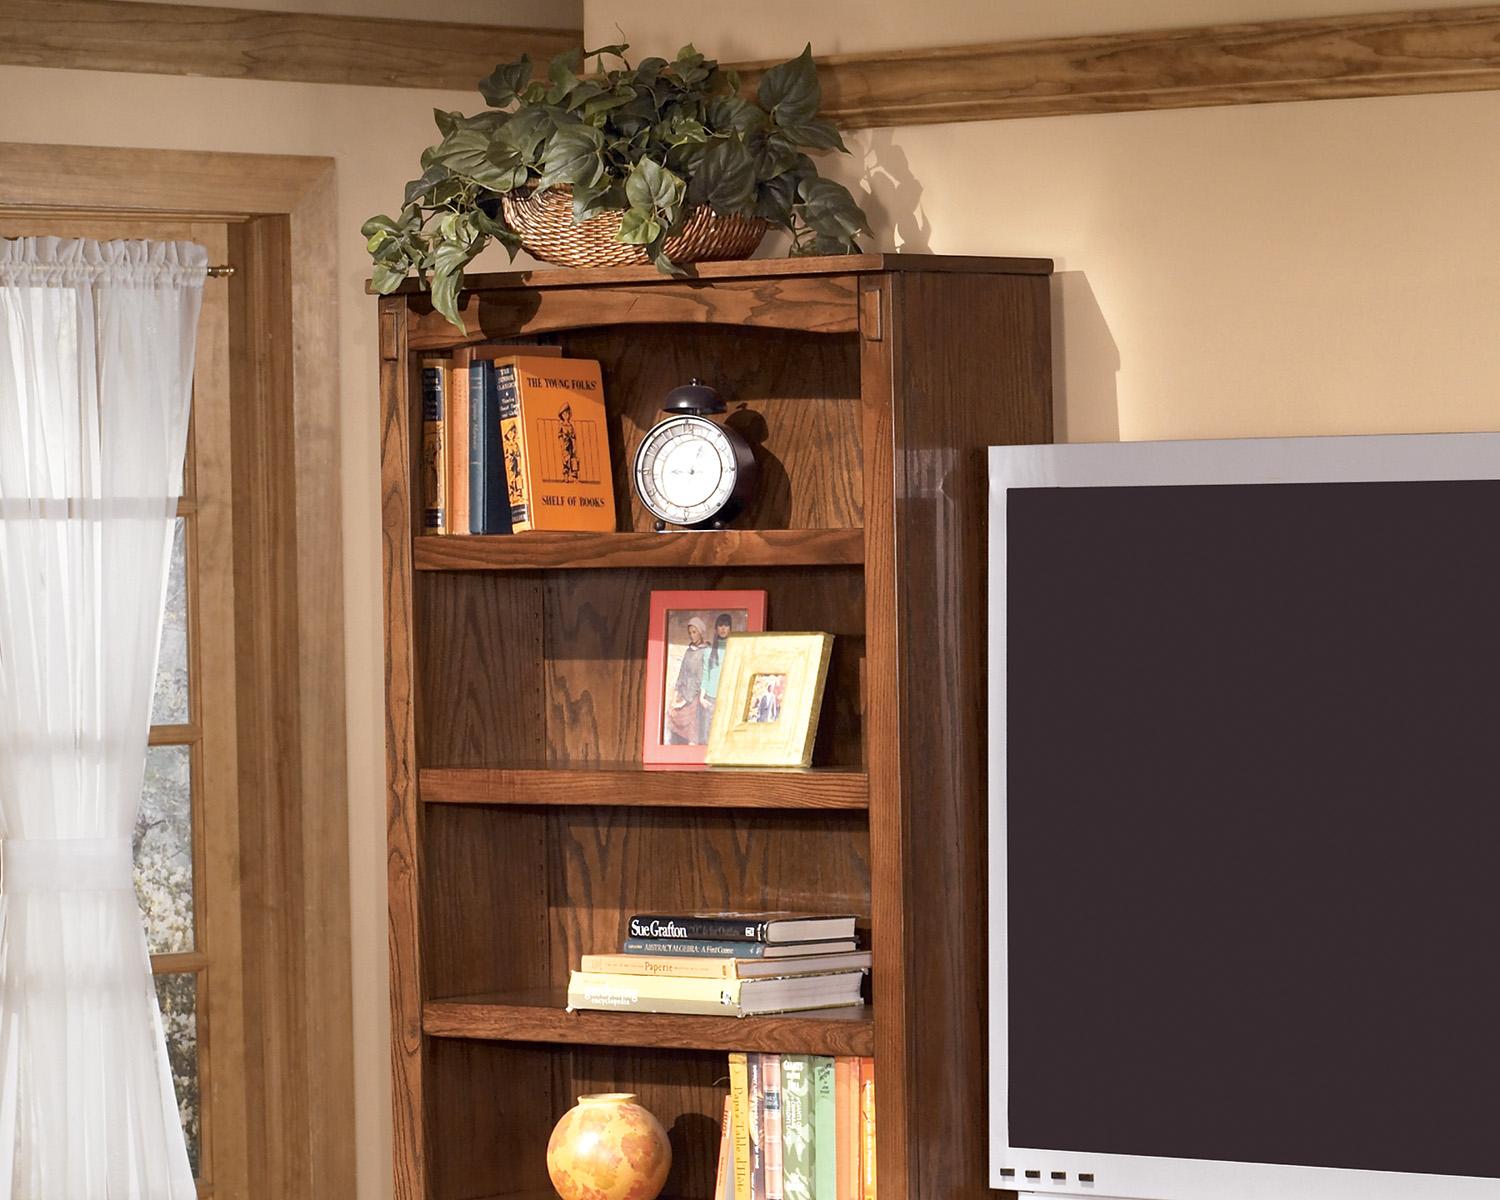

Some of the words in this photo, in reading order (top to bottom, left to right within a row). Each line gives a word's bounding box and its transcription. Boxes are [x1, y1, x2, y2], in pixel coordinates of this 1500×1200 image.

[527, 377, 542, 388] THE
[544, 378, 570, 389] YOUNG
[542, 496, 565, 507] SHELF
[567, 497, 577, 507] OF
[579, 497, 605, 508] BOOKS
[631, 919, 650, 937] Sue
[650, 920, 688, 938] Grafton
